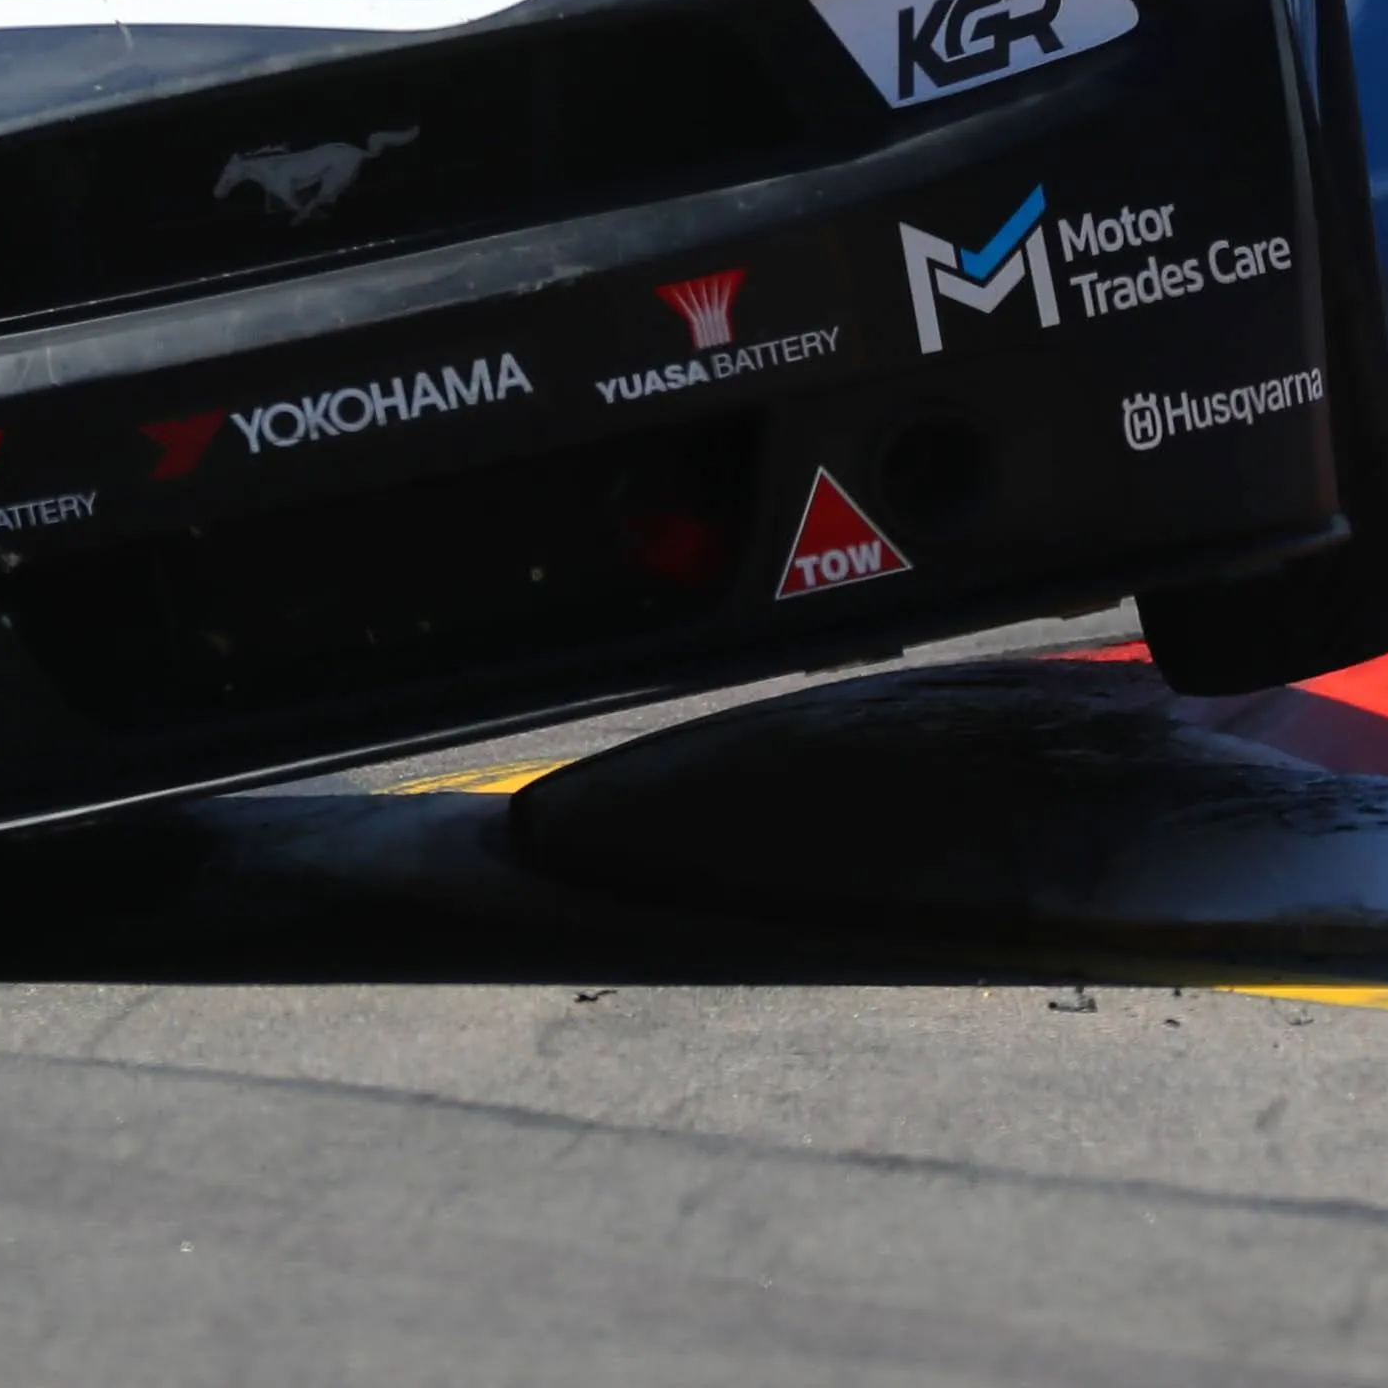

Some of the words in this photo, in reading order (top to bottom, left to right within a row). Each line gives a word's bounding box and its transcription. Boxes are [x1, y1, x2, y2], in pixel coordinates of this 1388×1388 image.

[1058, 203, 1175, 263] Motor
[1070, 256, 1204, 318] Trades
[1209, 236, 1293, 285] Care
[232, 352, 533, 454] YOKOHAMA
[596, 360, 710, 405] YUASA
[711, 326, 841, 380] BATTERY
[1164, 366, 1325, 437] Husqvarna
[794, 541, 884, 588] TOW
